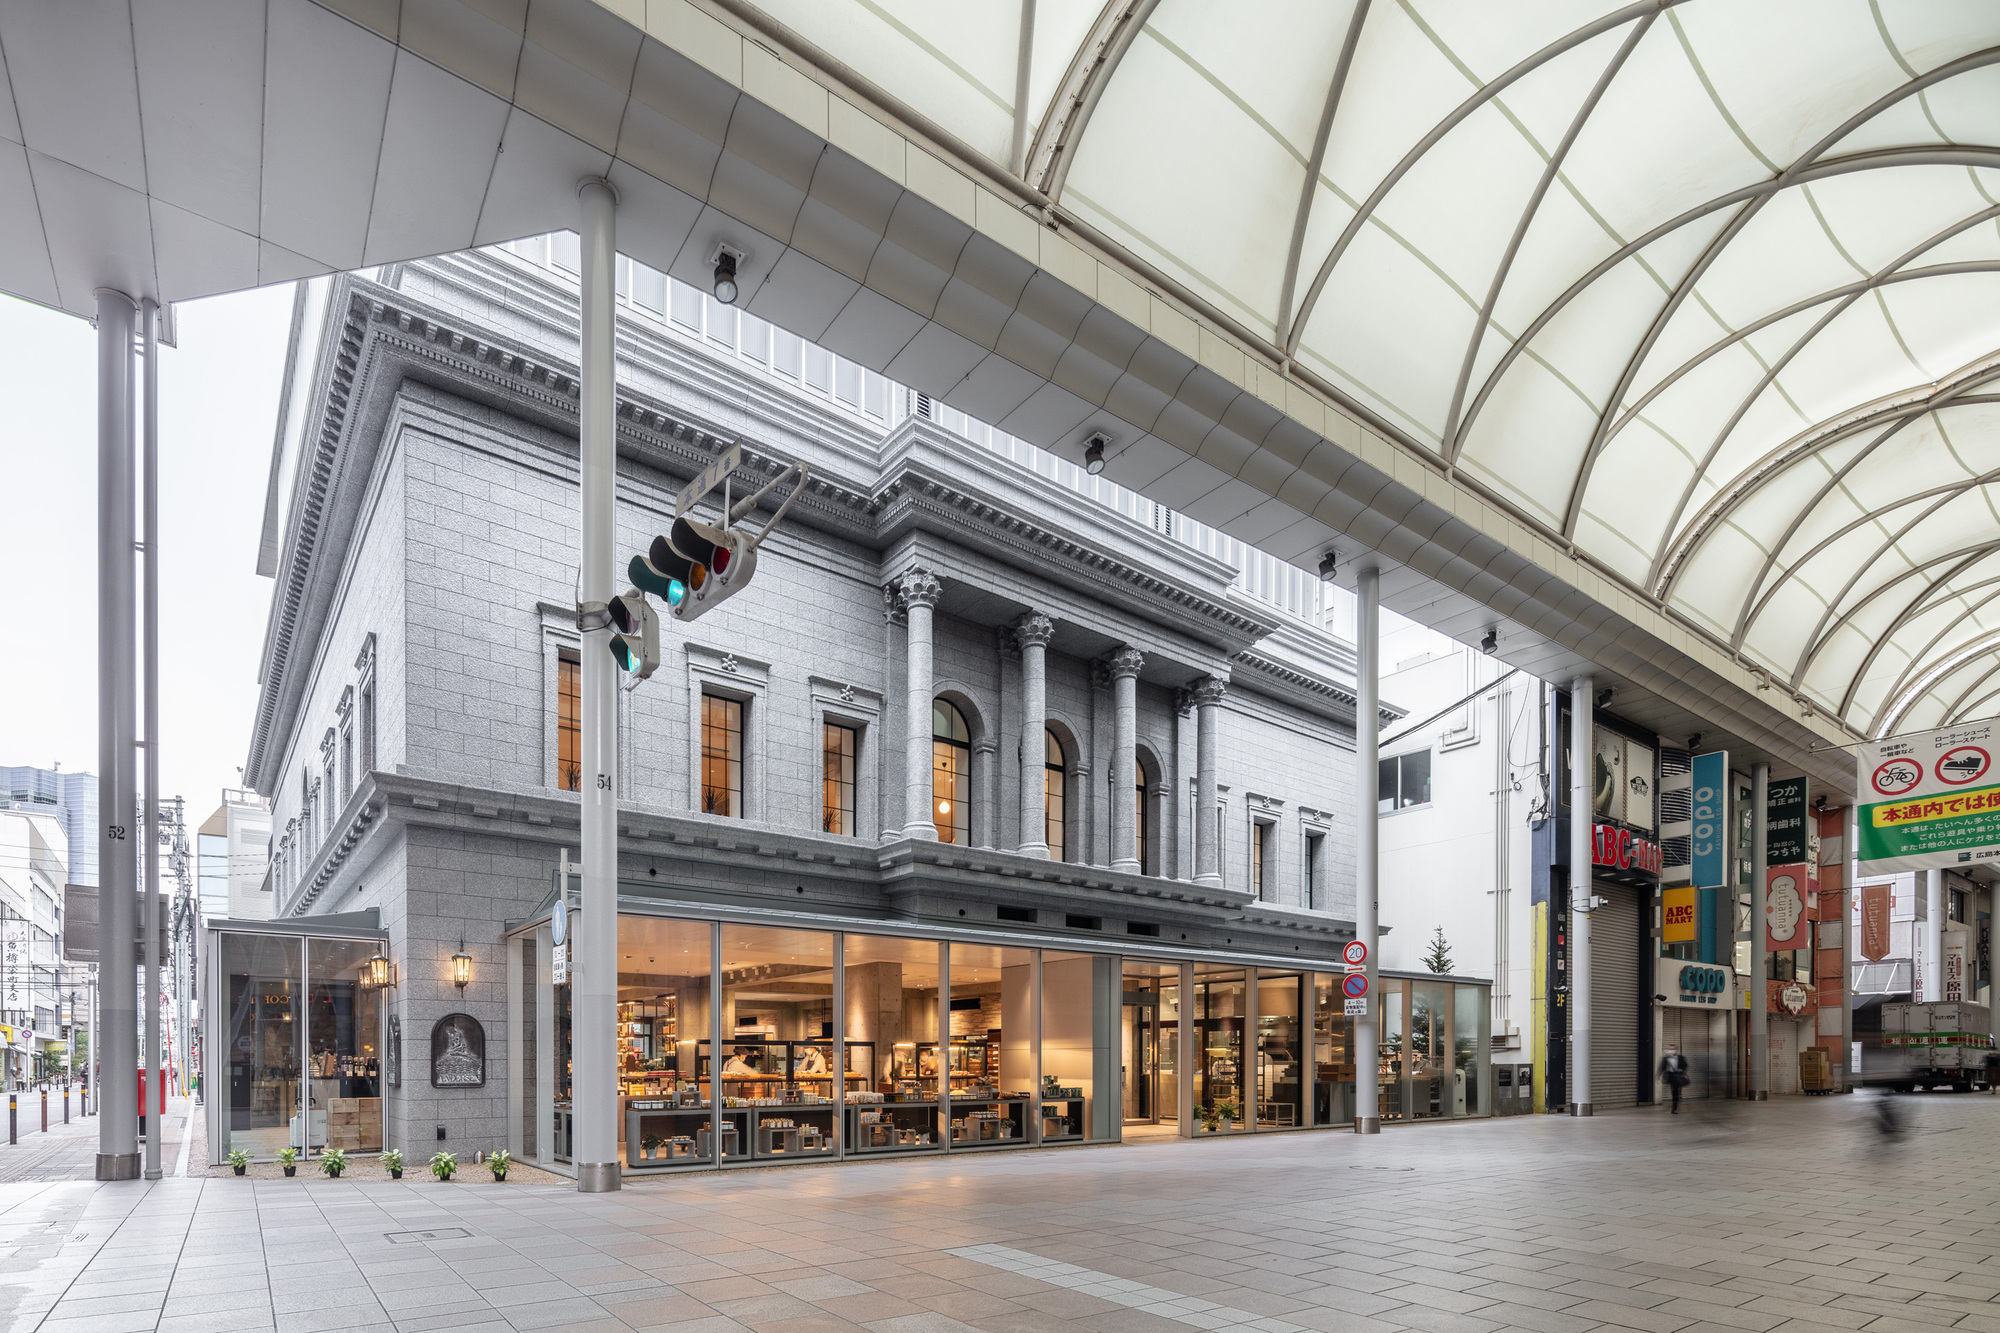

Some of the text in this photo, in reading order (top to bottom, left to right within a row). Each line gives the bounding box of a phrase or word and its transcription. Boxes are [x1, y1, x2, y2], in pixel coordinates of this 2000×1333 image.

[1935, 727, 1991, 742] ローラーシューズ
[1880, 743, 1908, 753] 自転車や
[1935, 734, 1991, 749] ローラースケート
[1880, 748, 1915, 758] 一輪車など
[597, 774, 612, 791] 54
[1768, 785, 1798, 799] つか
[108, 825, 125, 840] 52
[1768, 846, 1801, 857] つちや
[1666, 905, 1693, 918] ABC
[1666, 915, 1693, 925] MART
[1348, 947, 1362, 959] 20
